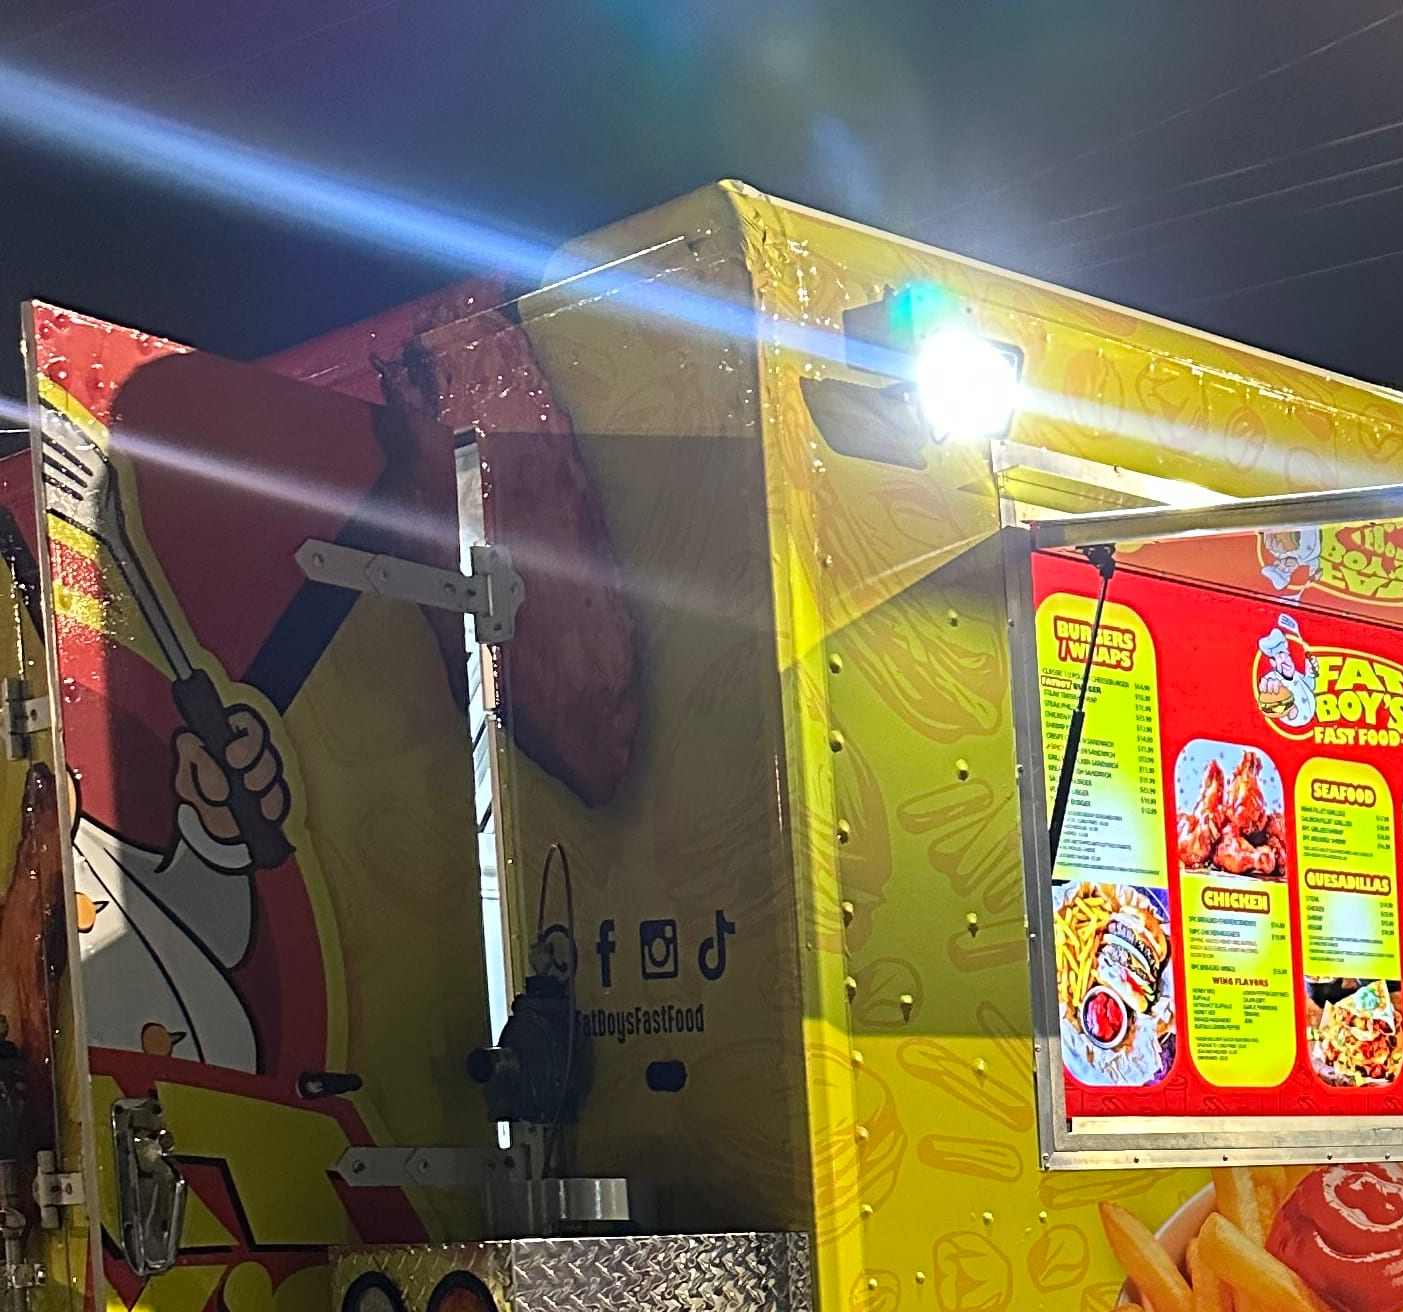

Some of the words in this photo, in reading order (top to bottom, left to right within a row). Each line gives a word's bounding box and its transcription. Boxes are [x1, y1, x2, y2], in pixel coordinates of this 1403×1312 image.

[1314, 726, 1355, 744] FAST
[1358, 728, 1401, 746] FOOD
[1312, 782, 1375, 805] SEAFOOD
[1306, 871, 1389, 893] QUESADILLAS
[1203, 890, 1269, 911] CHICKEN
[1212, 976, 1233, 986] WING
[1235, 978, 1269, 987] FLAVORS
[575, 1003, 705, 1044] FatBoysFastFood
